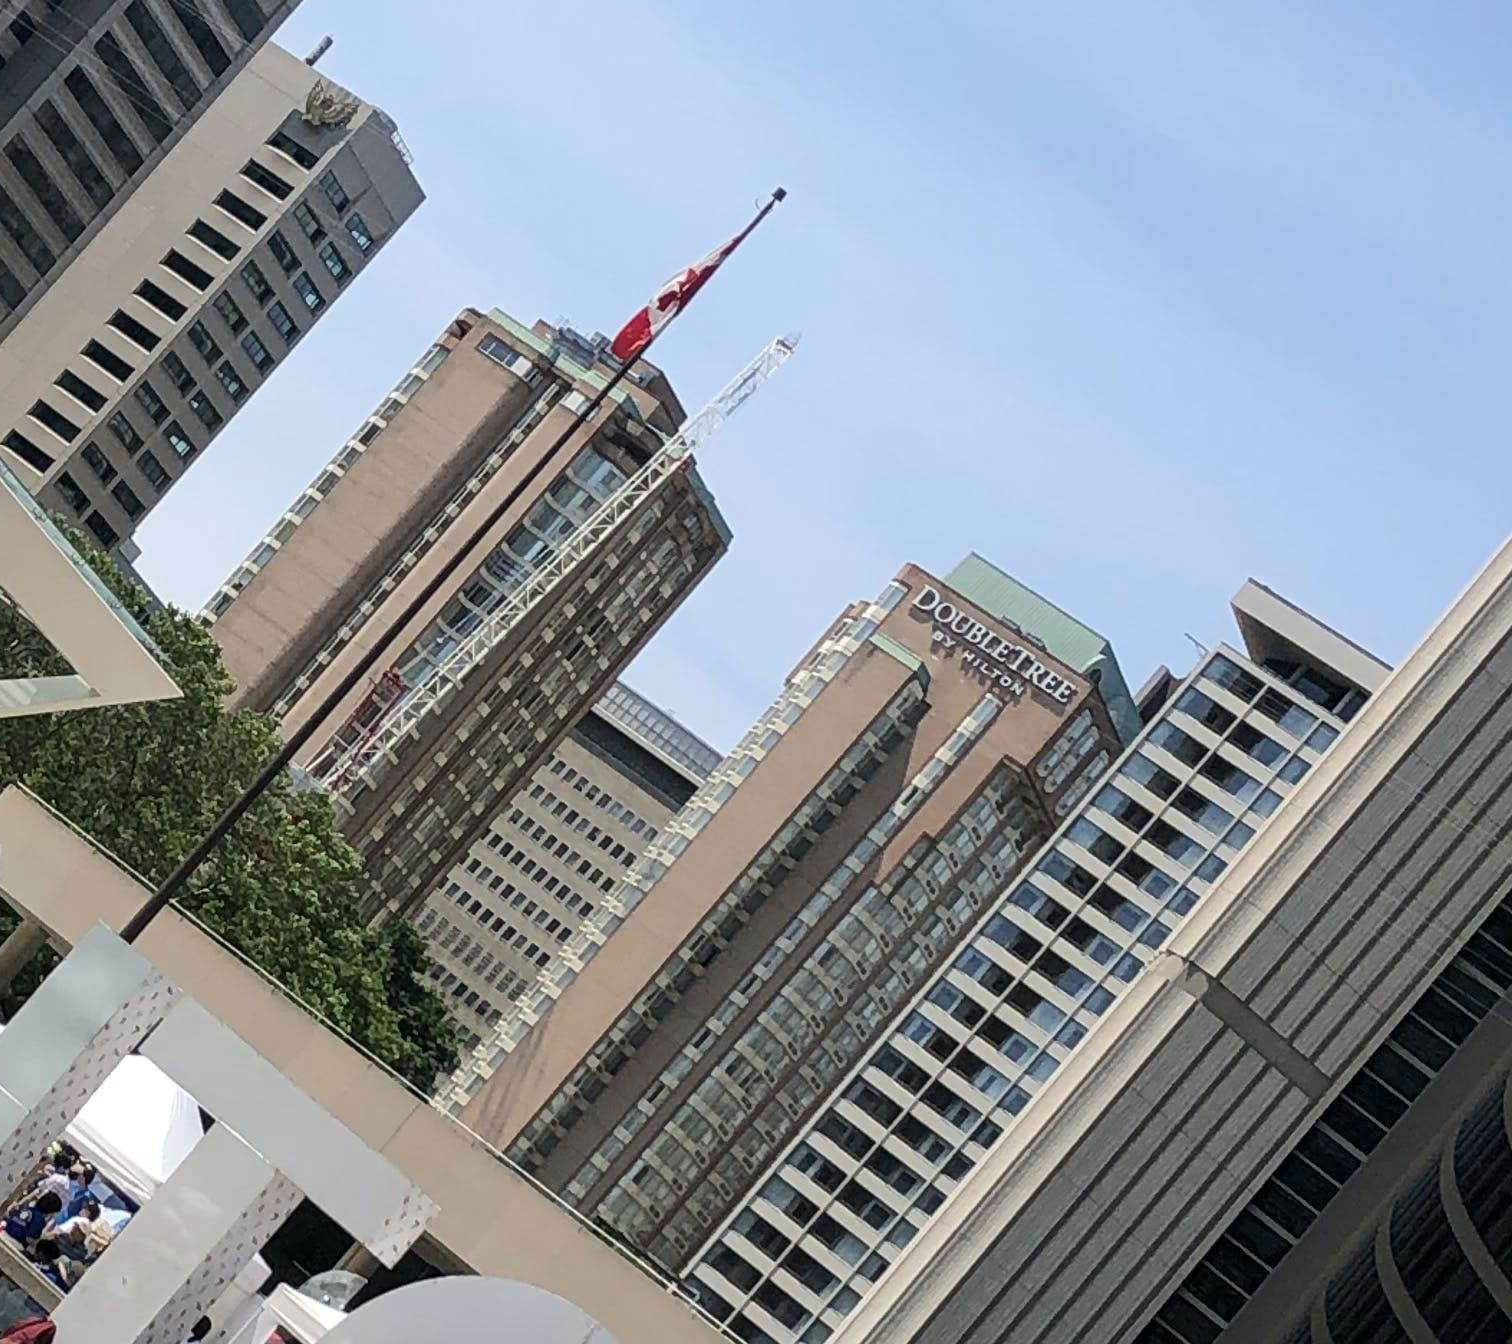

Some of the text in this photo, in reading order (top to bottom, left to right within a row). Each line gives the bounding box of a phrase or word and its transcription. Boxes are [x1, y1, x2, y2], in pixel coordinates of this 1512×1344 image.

[912, 585, 1075, 703] DOUBLETREE
[932, 630, 1025, 696] BY HILTON
